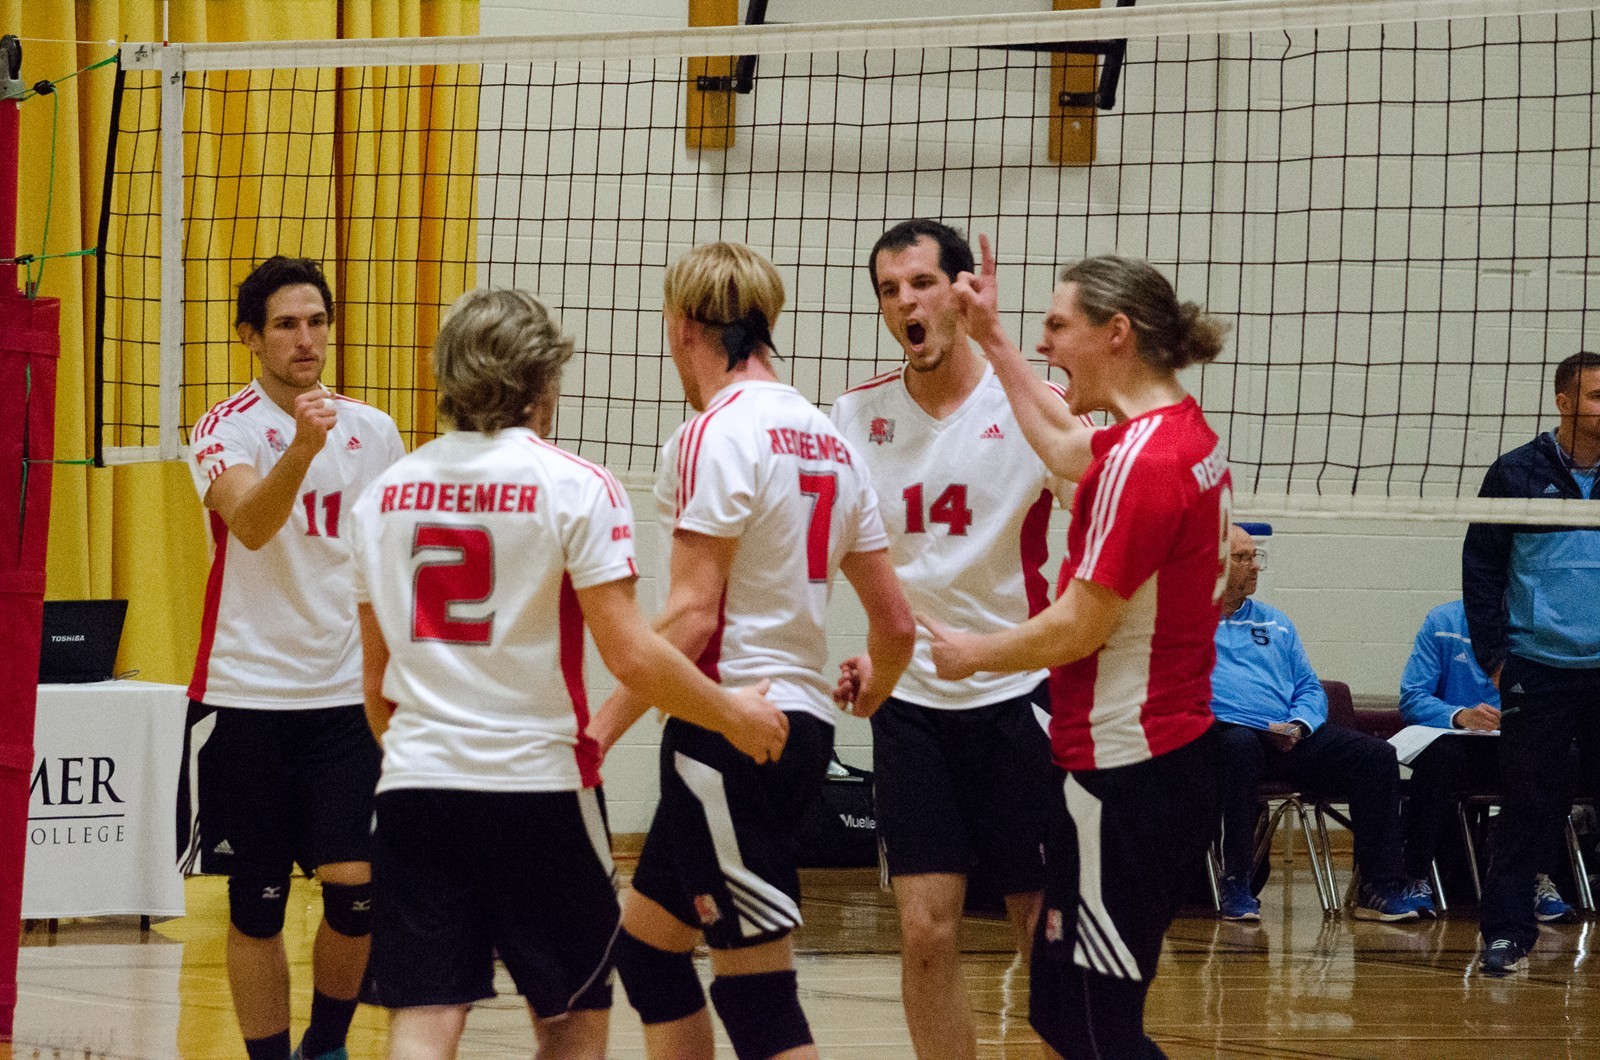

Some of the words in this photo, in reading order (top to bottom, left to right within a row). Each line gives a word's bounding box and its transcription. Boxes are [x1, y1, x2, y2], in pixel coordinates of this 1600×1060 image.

[302, 489, 342, 538] 11
[380, 481, 538, 514] REDEEMER
[902, 482, 973, 536] 14
[799, 470, 838, 583] 7
[411, 522, 496, 646] 2
[51, 634, 86, 642] TOSHIBA
[1250, 628, 1271, 646] S
[29, 756, 125, 806] MER
[30, 825, 125, 846] OLLEGE
[839, 813, 877, 829] Muelle
